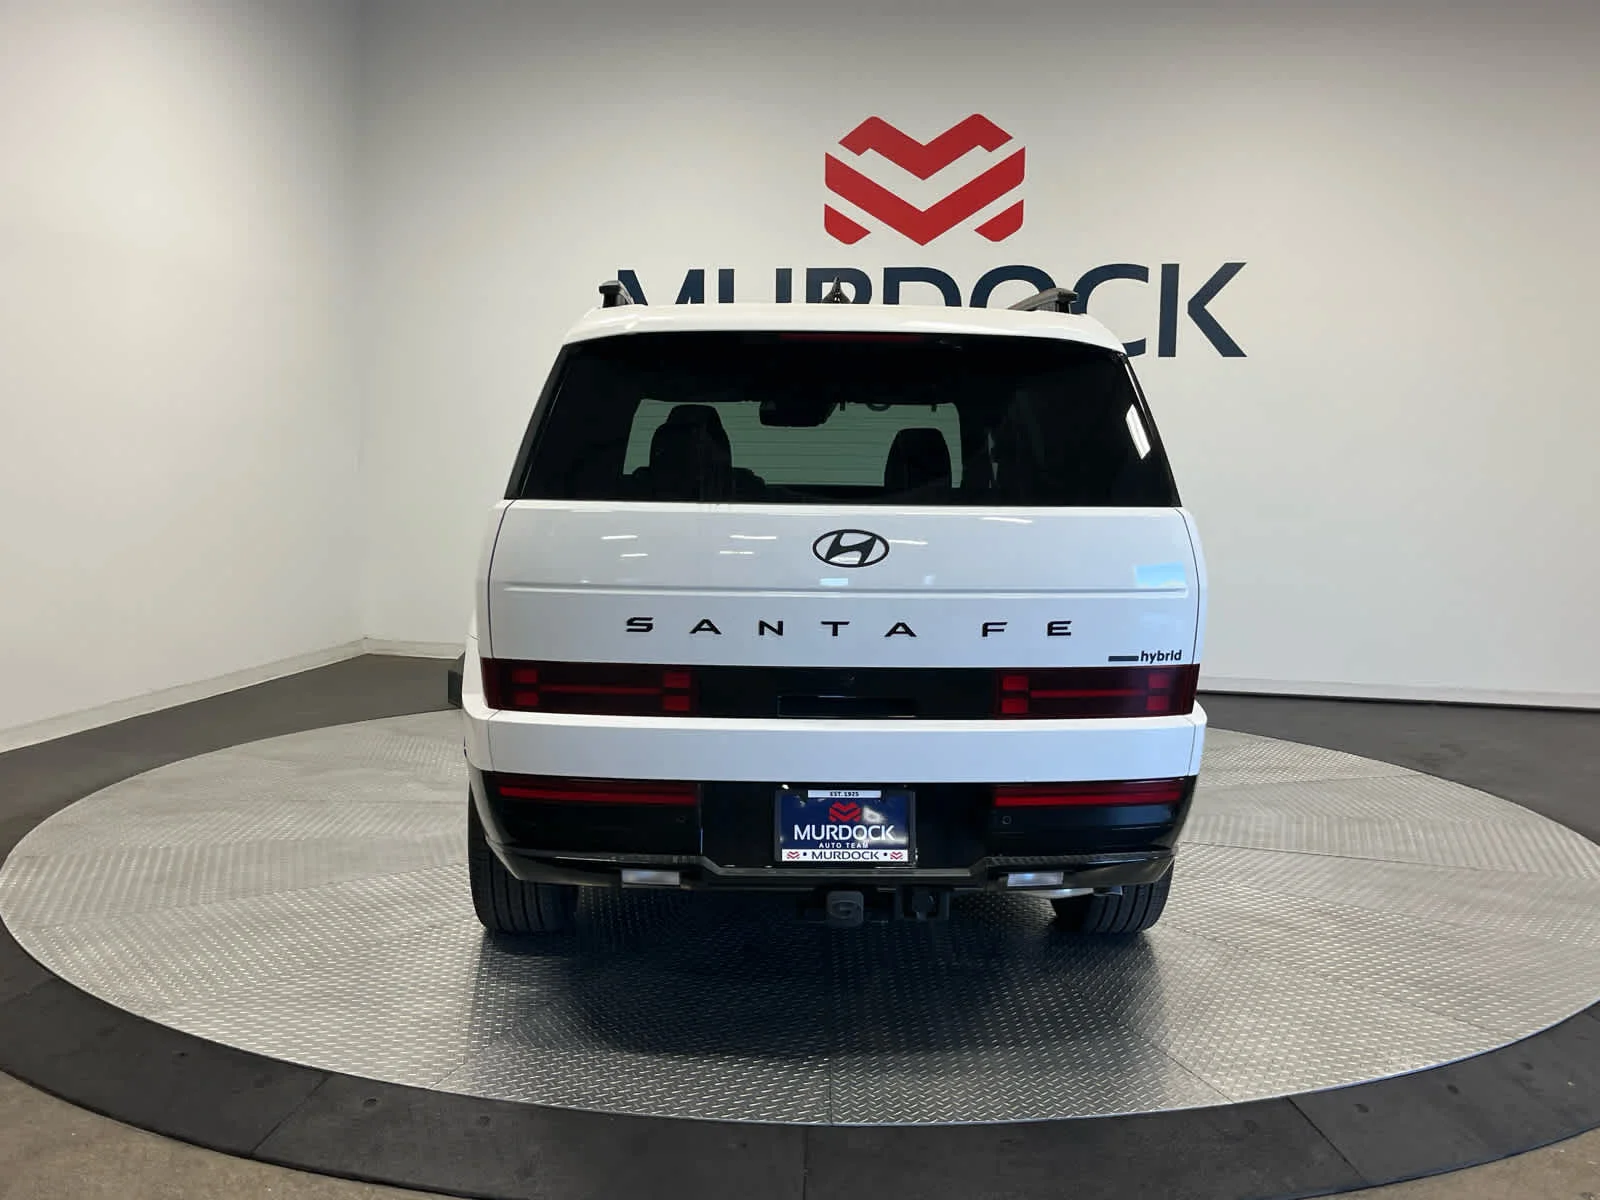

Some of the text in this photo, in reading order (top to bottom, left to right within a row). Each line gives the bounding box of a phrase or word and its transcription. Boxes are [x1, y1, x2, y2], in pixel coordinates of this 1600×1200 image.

[626, 617, 1073, 638] SANTA FE
[1140, 649, 1182, 664] hybrid
[794, 824, 895, 840] MURDOCK
[811, 851, 880, 860] MURDOCK
